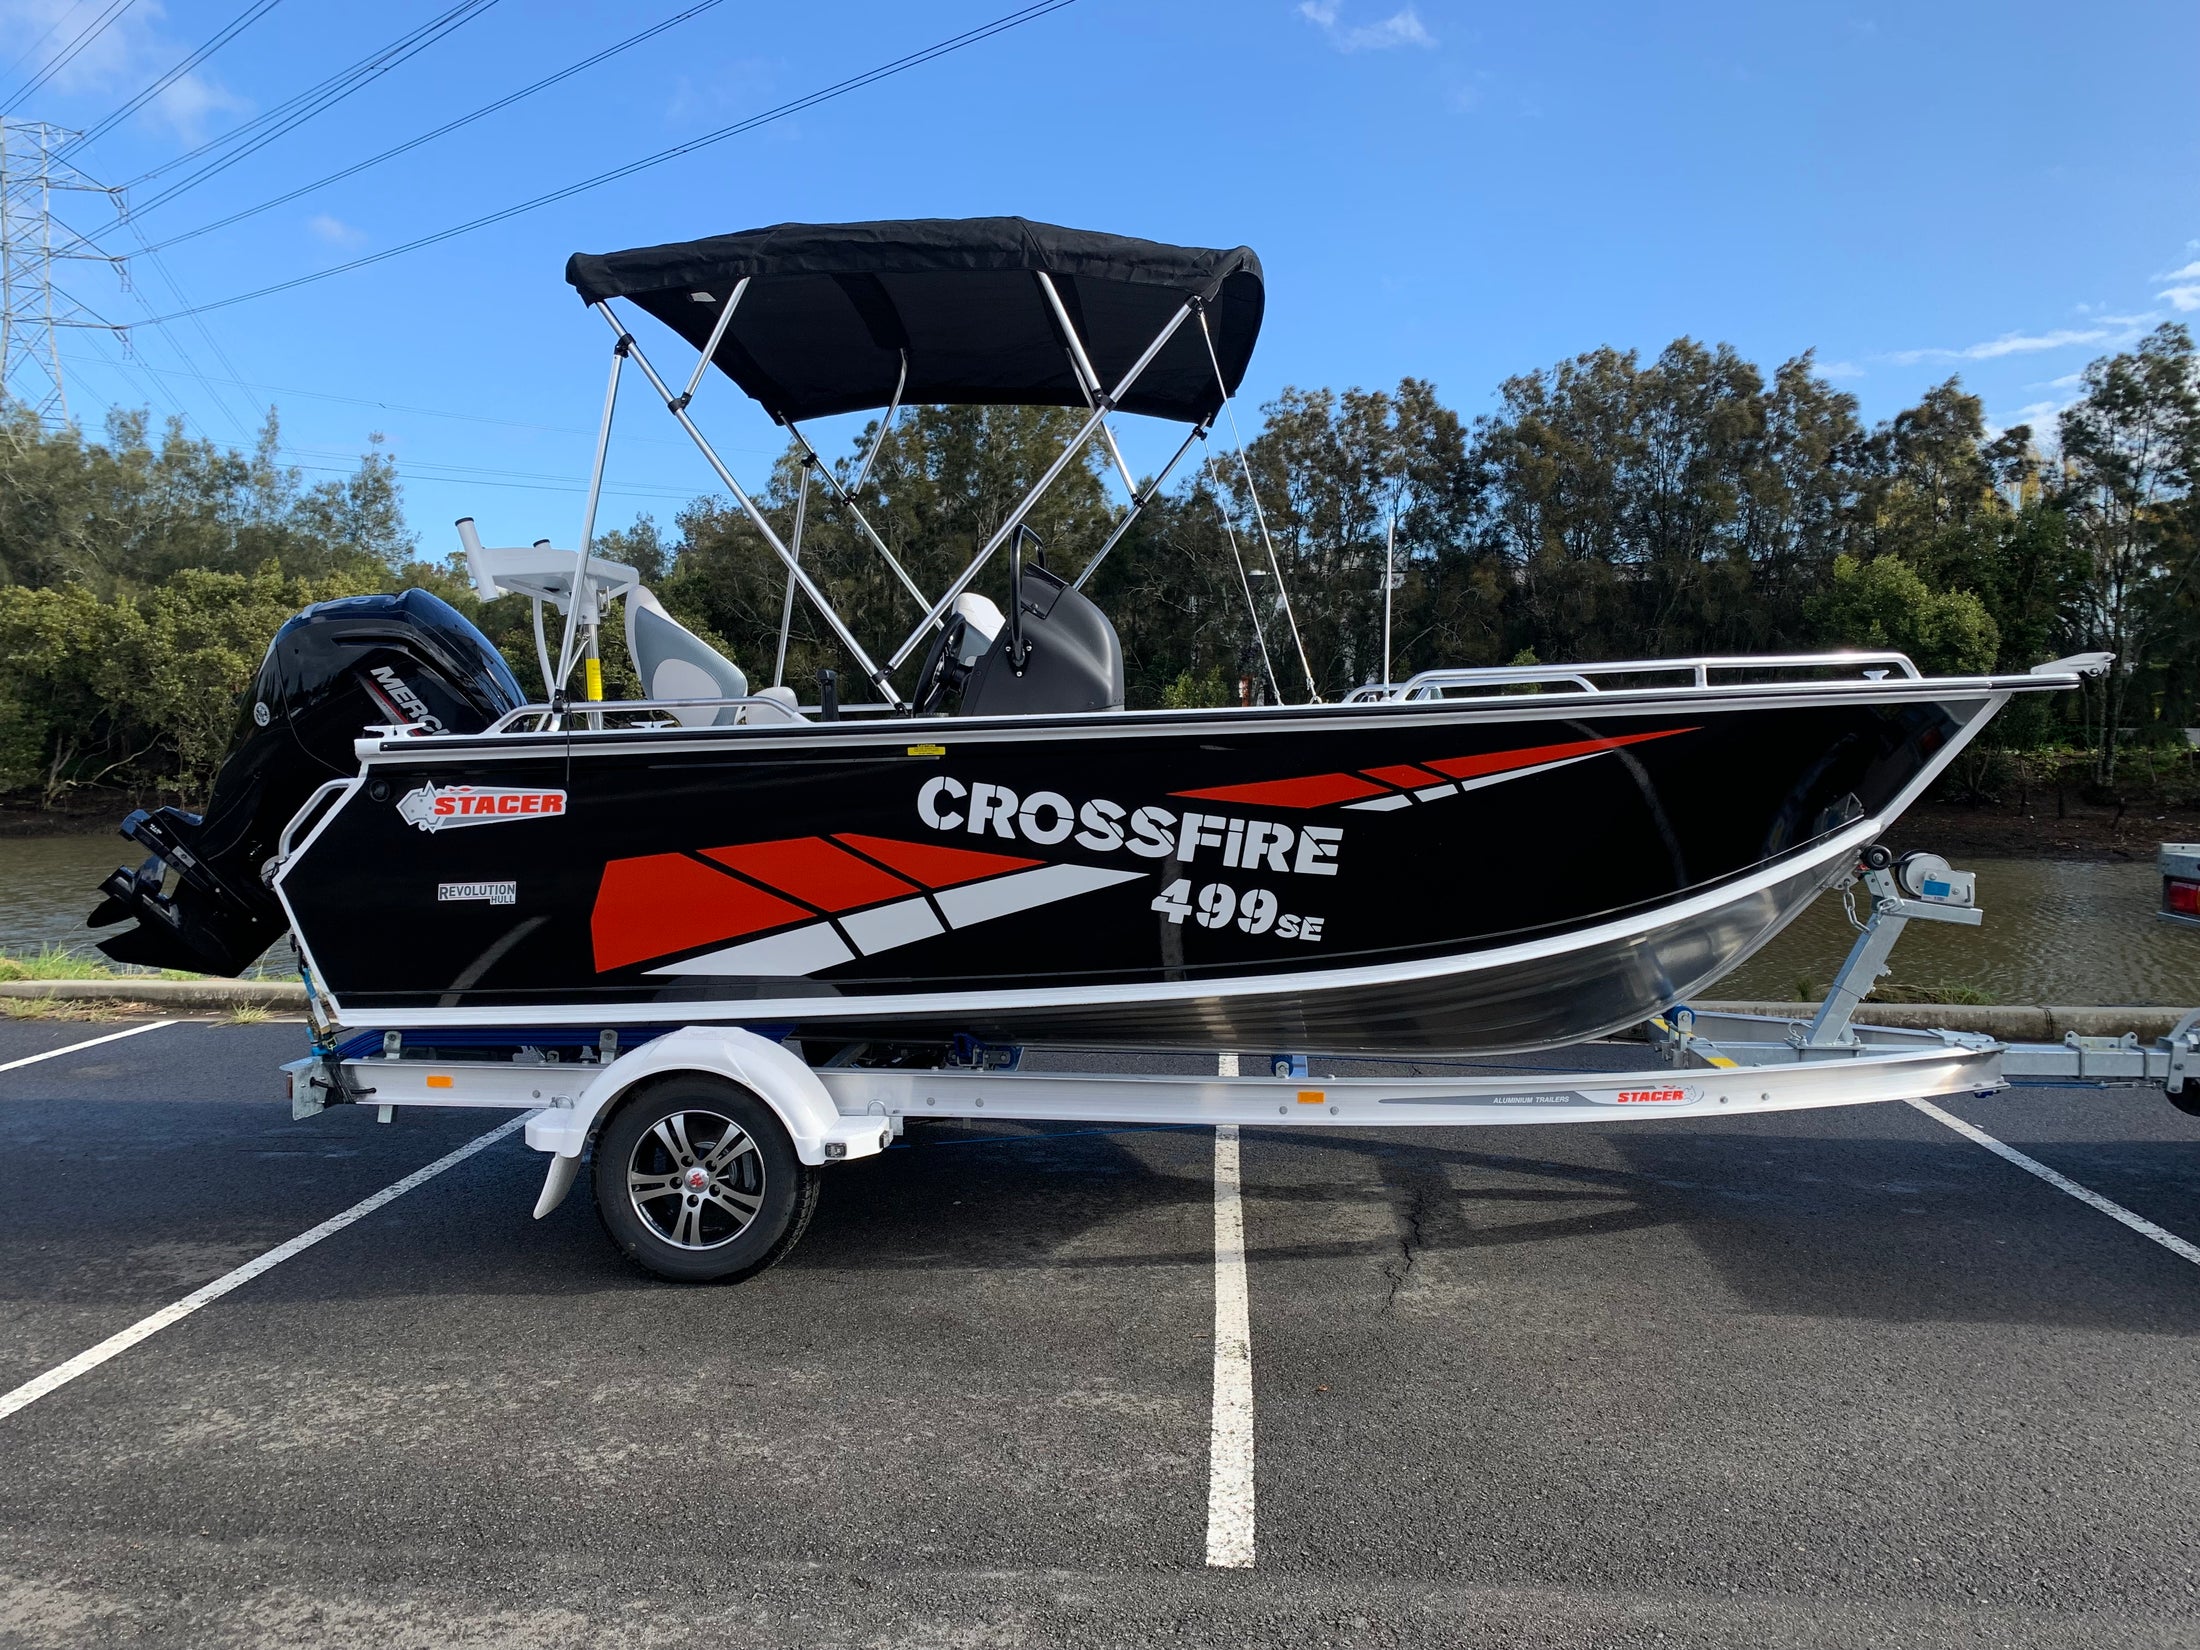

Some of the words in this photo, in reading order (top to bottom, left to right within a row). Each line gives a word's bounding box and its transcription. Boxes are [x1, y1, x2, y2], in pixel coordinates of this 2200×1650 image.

[370, 666, 450, 735] MERC
[434, 795, 563, 815] STACER
[917, 776, 1343, 876] CROSSFIRE
[491, 895, 514, 903] HULL
[1493, 1096, 1533, 1104] ALUMINIUM
[1618, 1090, 1684, 1103] STACER
